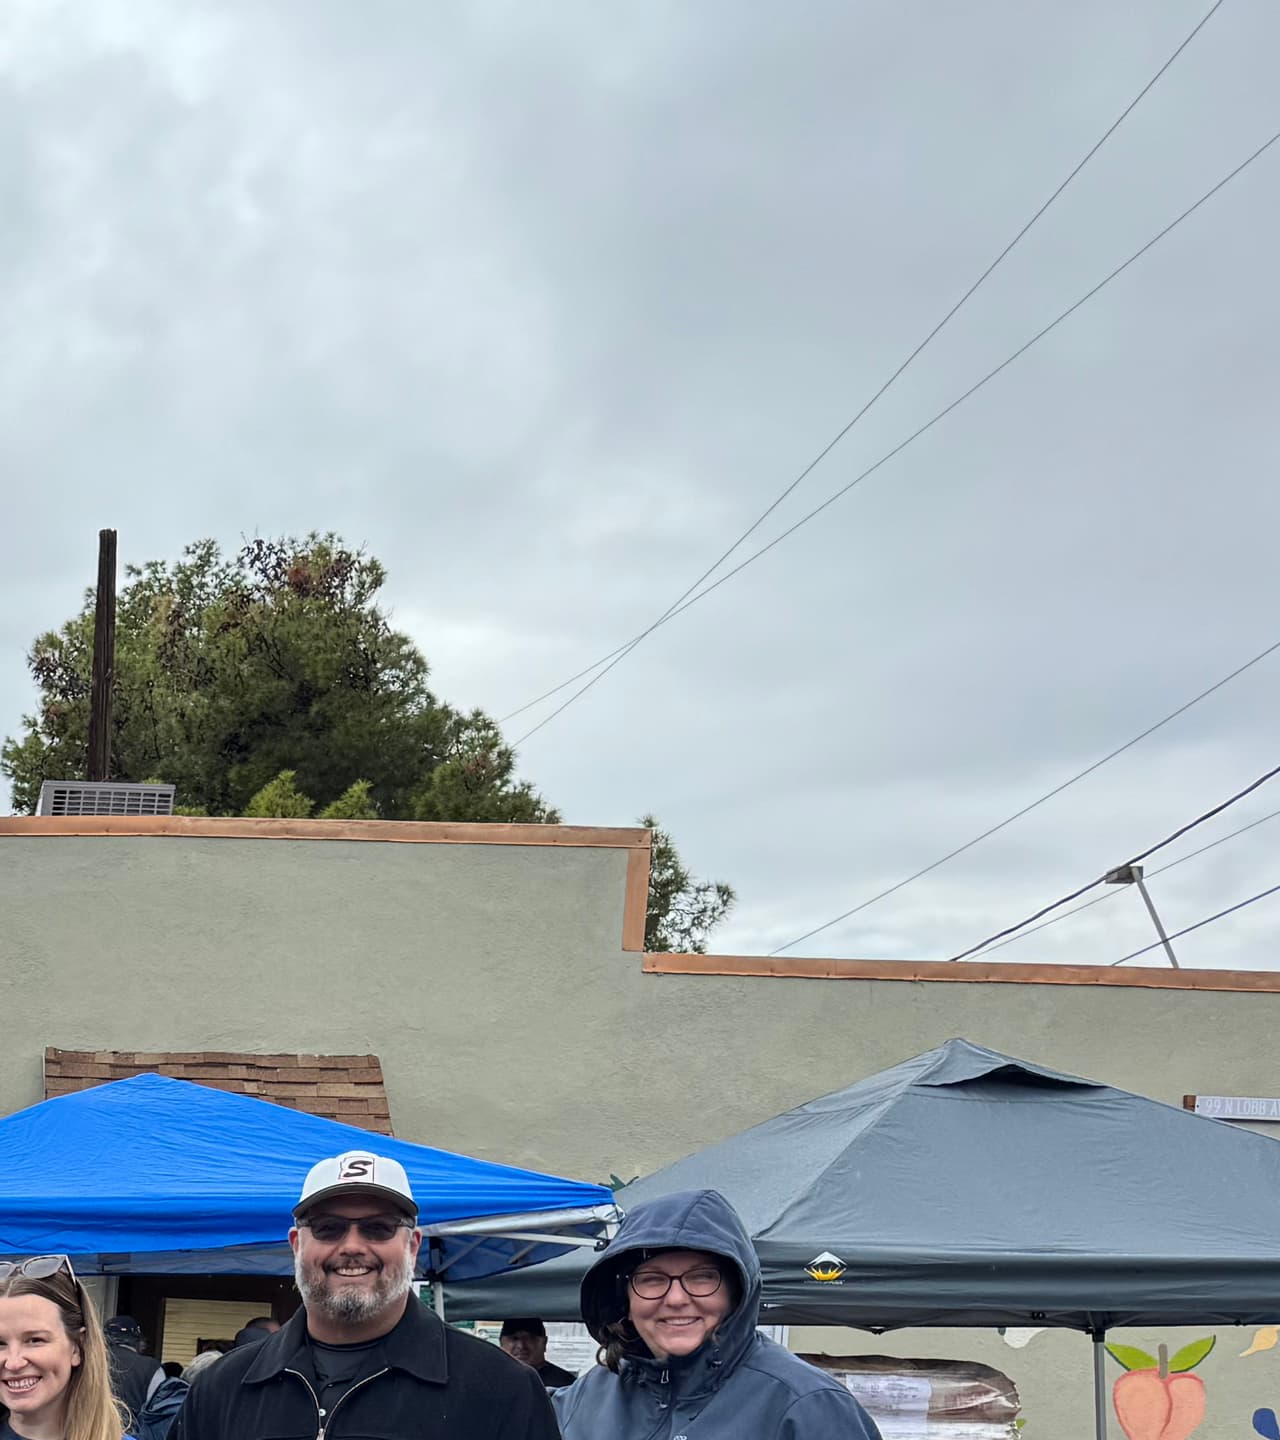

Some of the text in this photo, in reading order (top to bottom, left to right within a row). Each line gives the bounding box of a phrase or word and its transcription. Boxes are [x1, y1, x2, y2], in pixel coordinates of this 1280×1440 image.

[1206, 1098, 1220, 1116] 99
[1224, 1099, 1233, 1116] N
[343, 1160, 373, 1178] S
